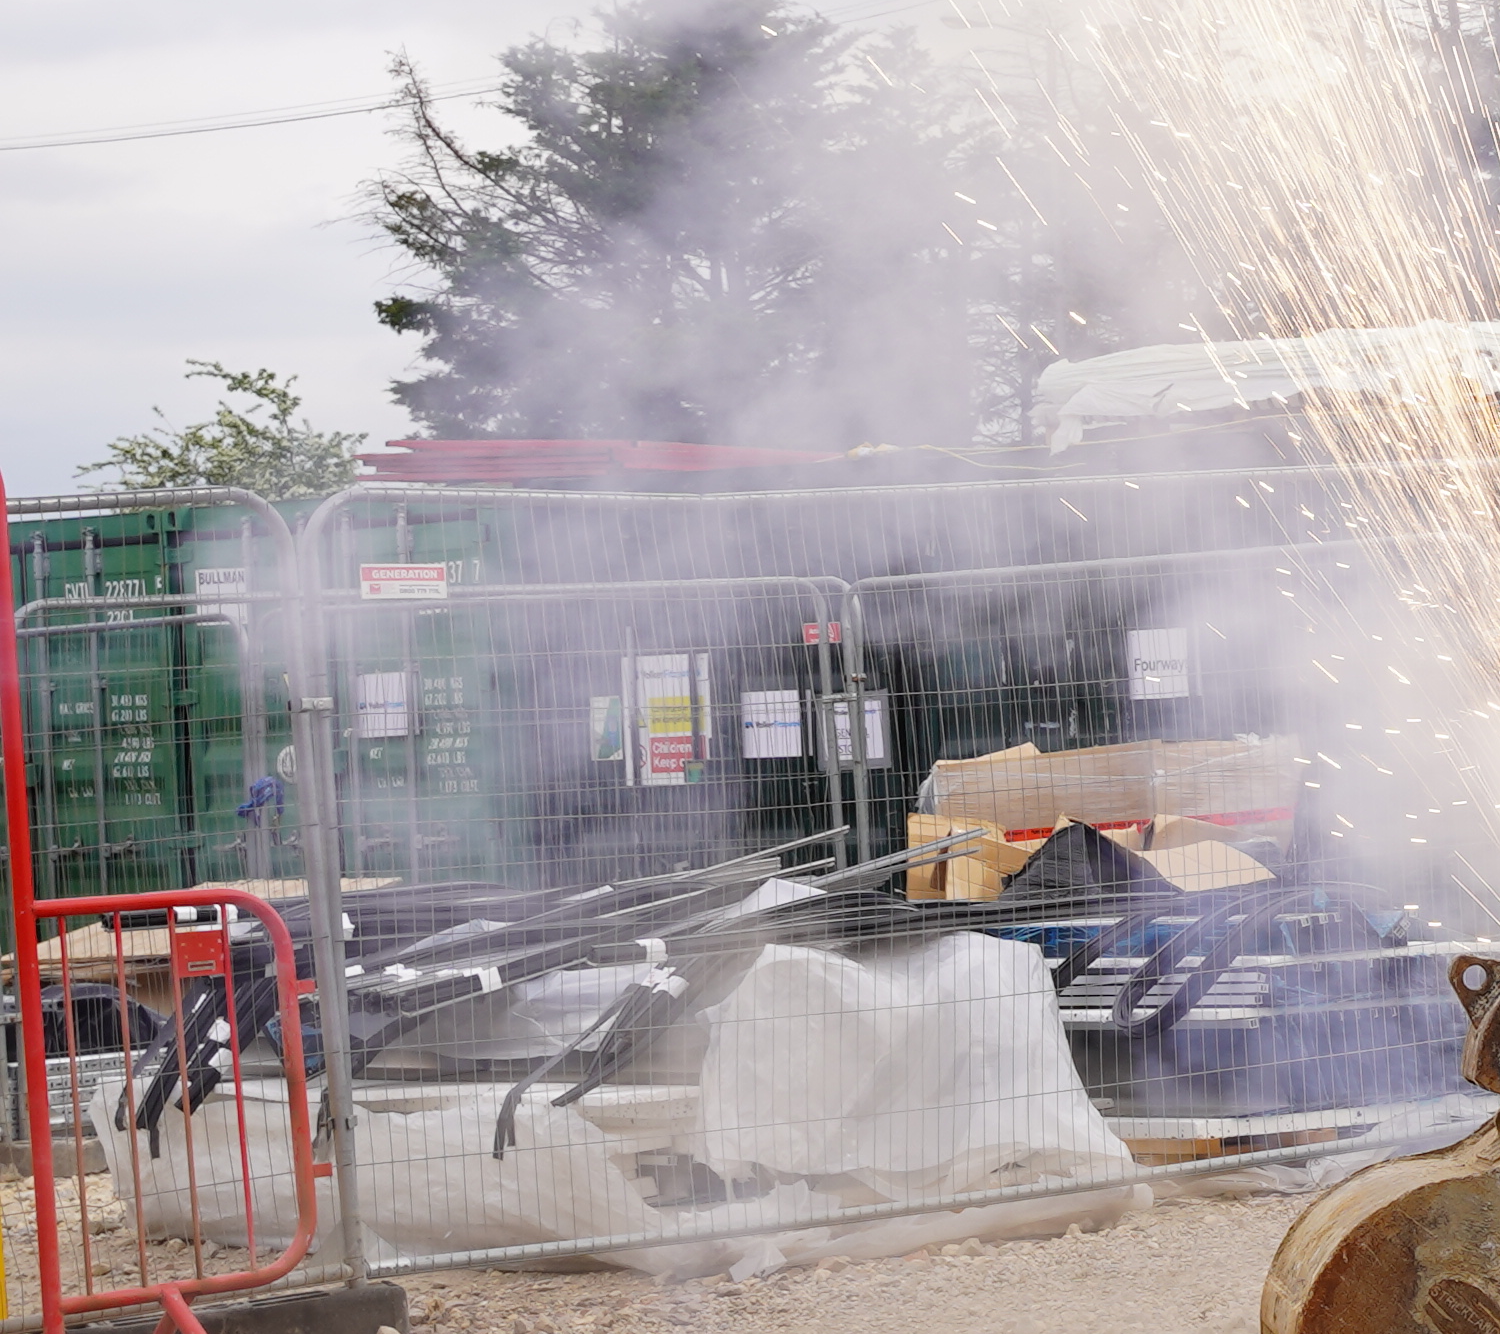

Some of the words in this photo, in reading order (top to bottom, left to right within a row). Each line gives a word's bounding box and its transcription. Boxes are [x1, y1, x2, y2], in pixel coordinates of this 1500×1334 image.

[199, 571, 244, 585] BULLMAN
[372, 570, 438, 579] GENERATION
[652, 741, 692, 754] Children
[653, 756, 678, 769] Keep
